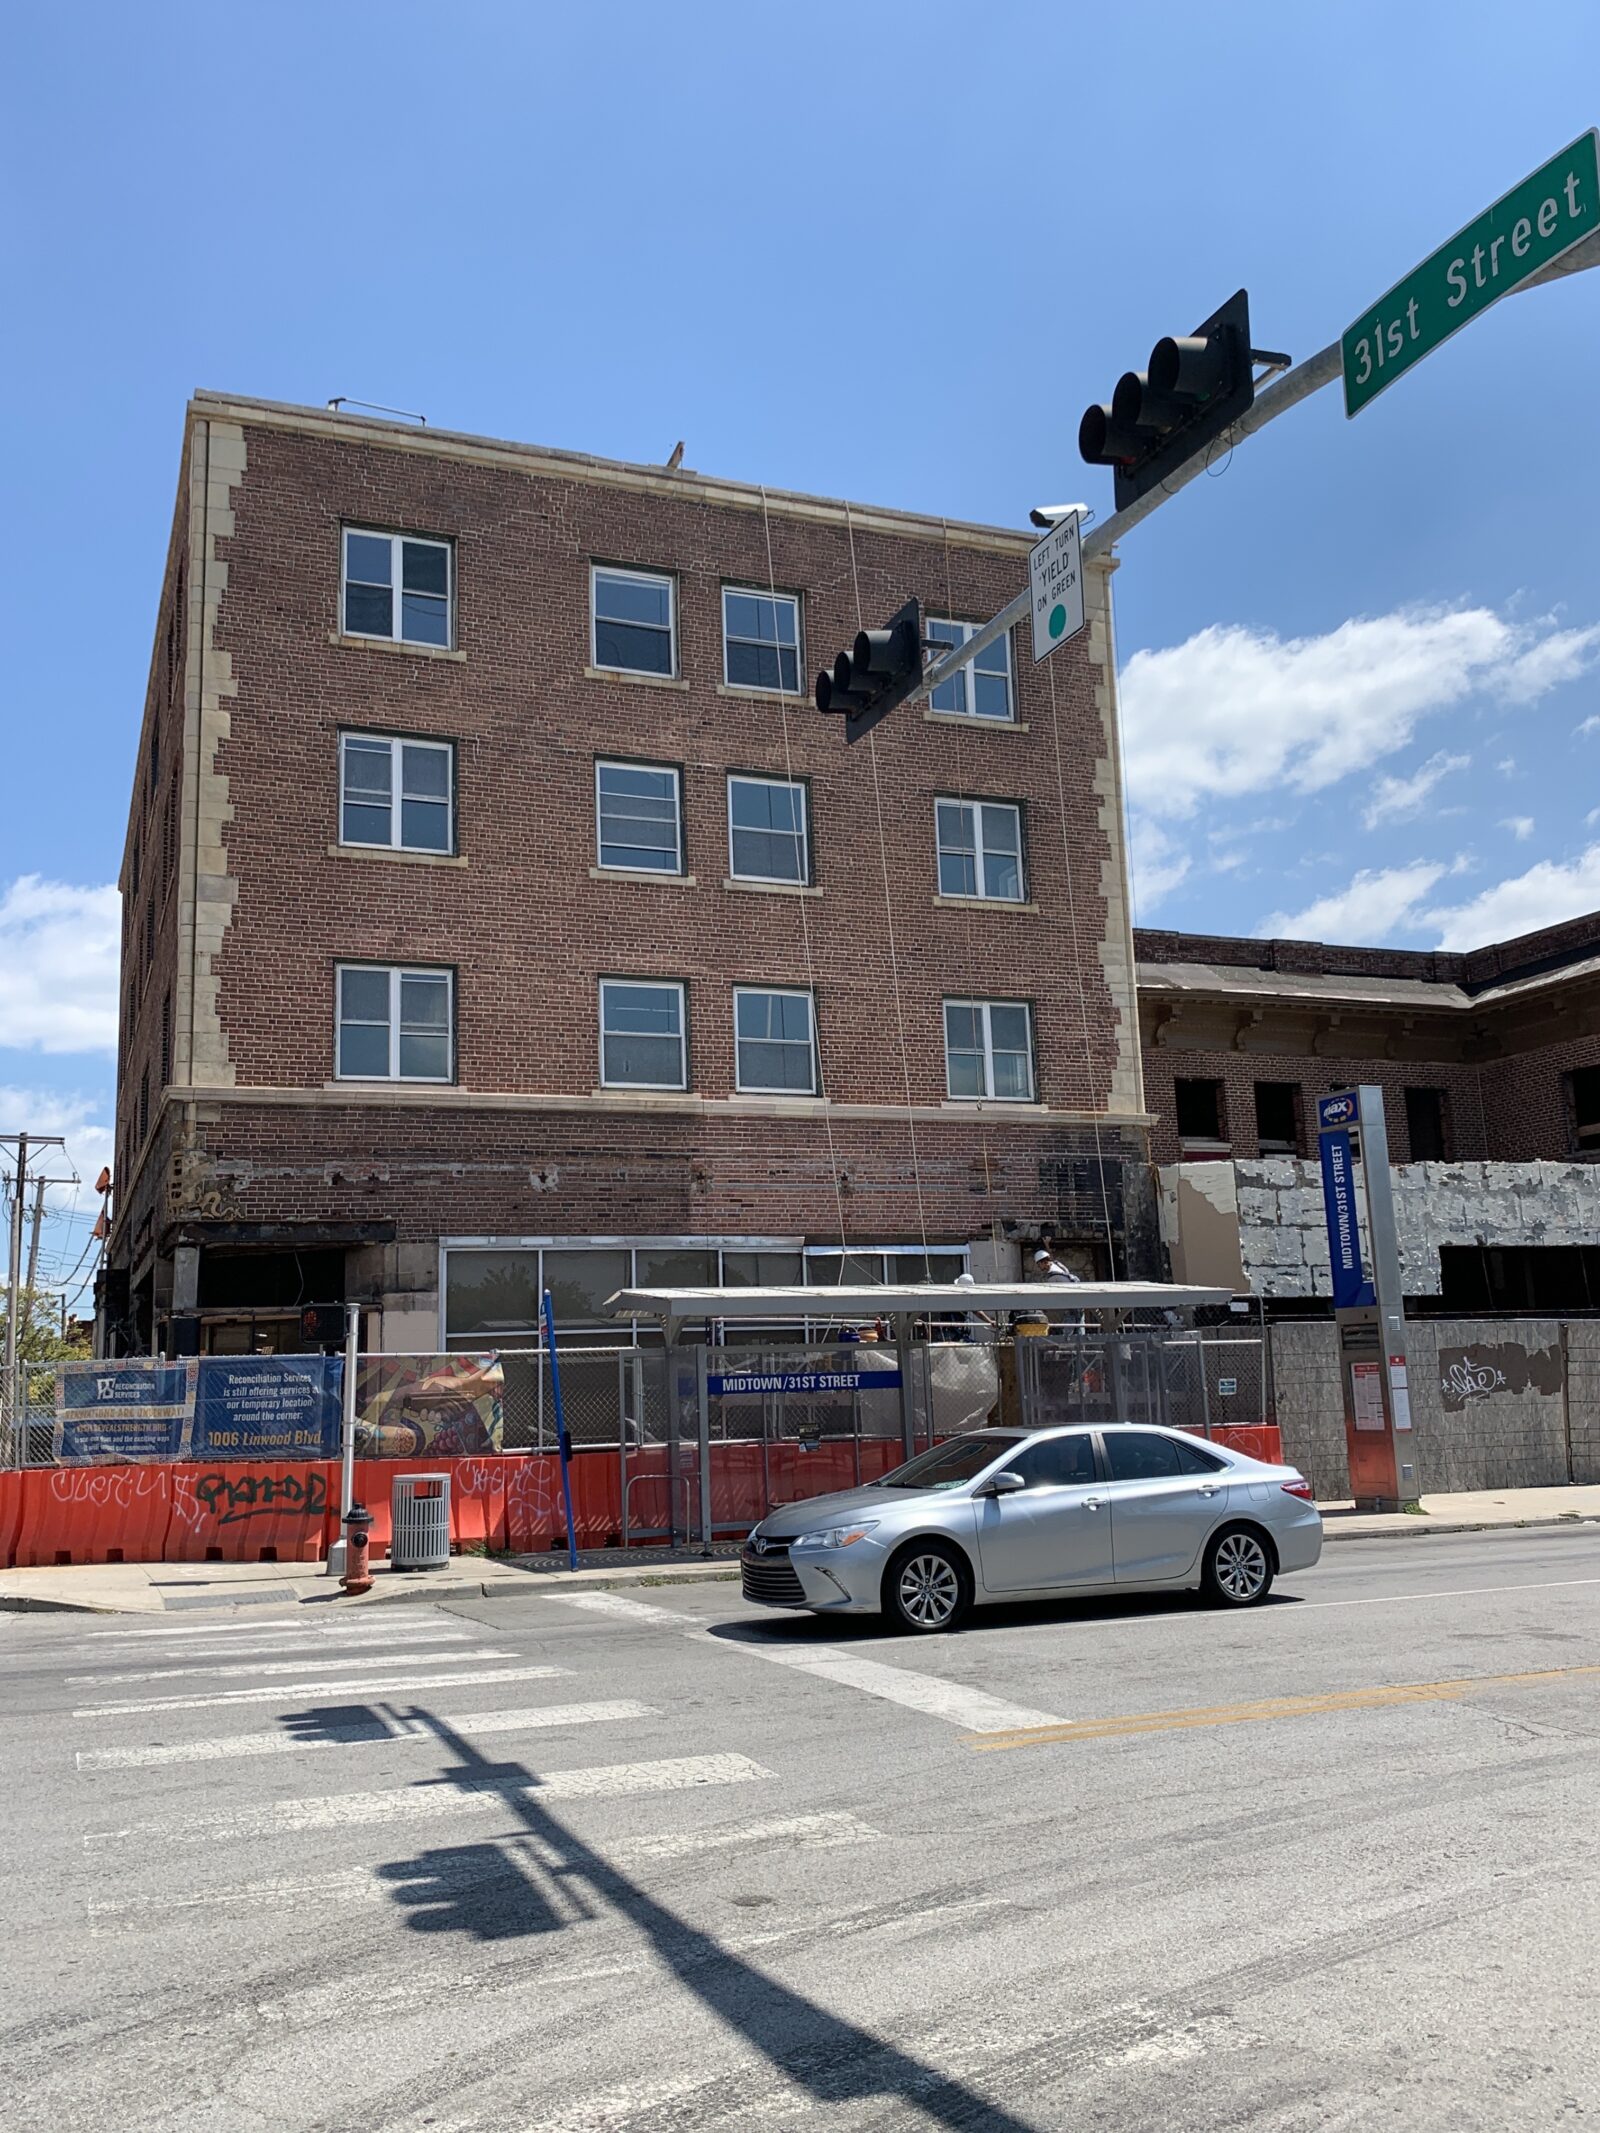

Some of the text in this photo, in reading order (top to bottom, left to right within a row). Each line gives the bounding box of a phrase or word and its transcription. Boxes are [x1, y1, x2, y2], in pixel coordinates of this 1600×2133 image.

[1355, 171, 1581, 384] 31st Street
[1033, 525, 1074, 571] LEFT TURN
[1041, 552, 1069, 587] YIELD
[1037, 570, 1076, 612] ON GREEN
[1331, 1145, 1353, 1269] MIDTOWN/31ST STREET
[228, 1373, 312, 1385] Reconciliation Services
[722, 1375, 861, 1391] MIDTOWN/31ST STREET
[114, 1391, 141, 1399] SERVICES
[223, 1388, 230, 1396] is
[231, 1387, 247, 1397] still
[249, 1386, 278, 1397] offering
[279, 1385, 310, 1395] services
[226, 1398, 313, 1410] our temporary location
[119, 1408, 134, 1418] ARE
[233, 1412, 303, 1421] around the corner:
[208, 1429, 325, 1447] 1006 Linwood Blvd.
